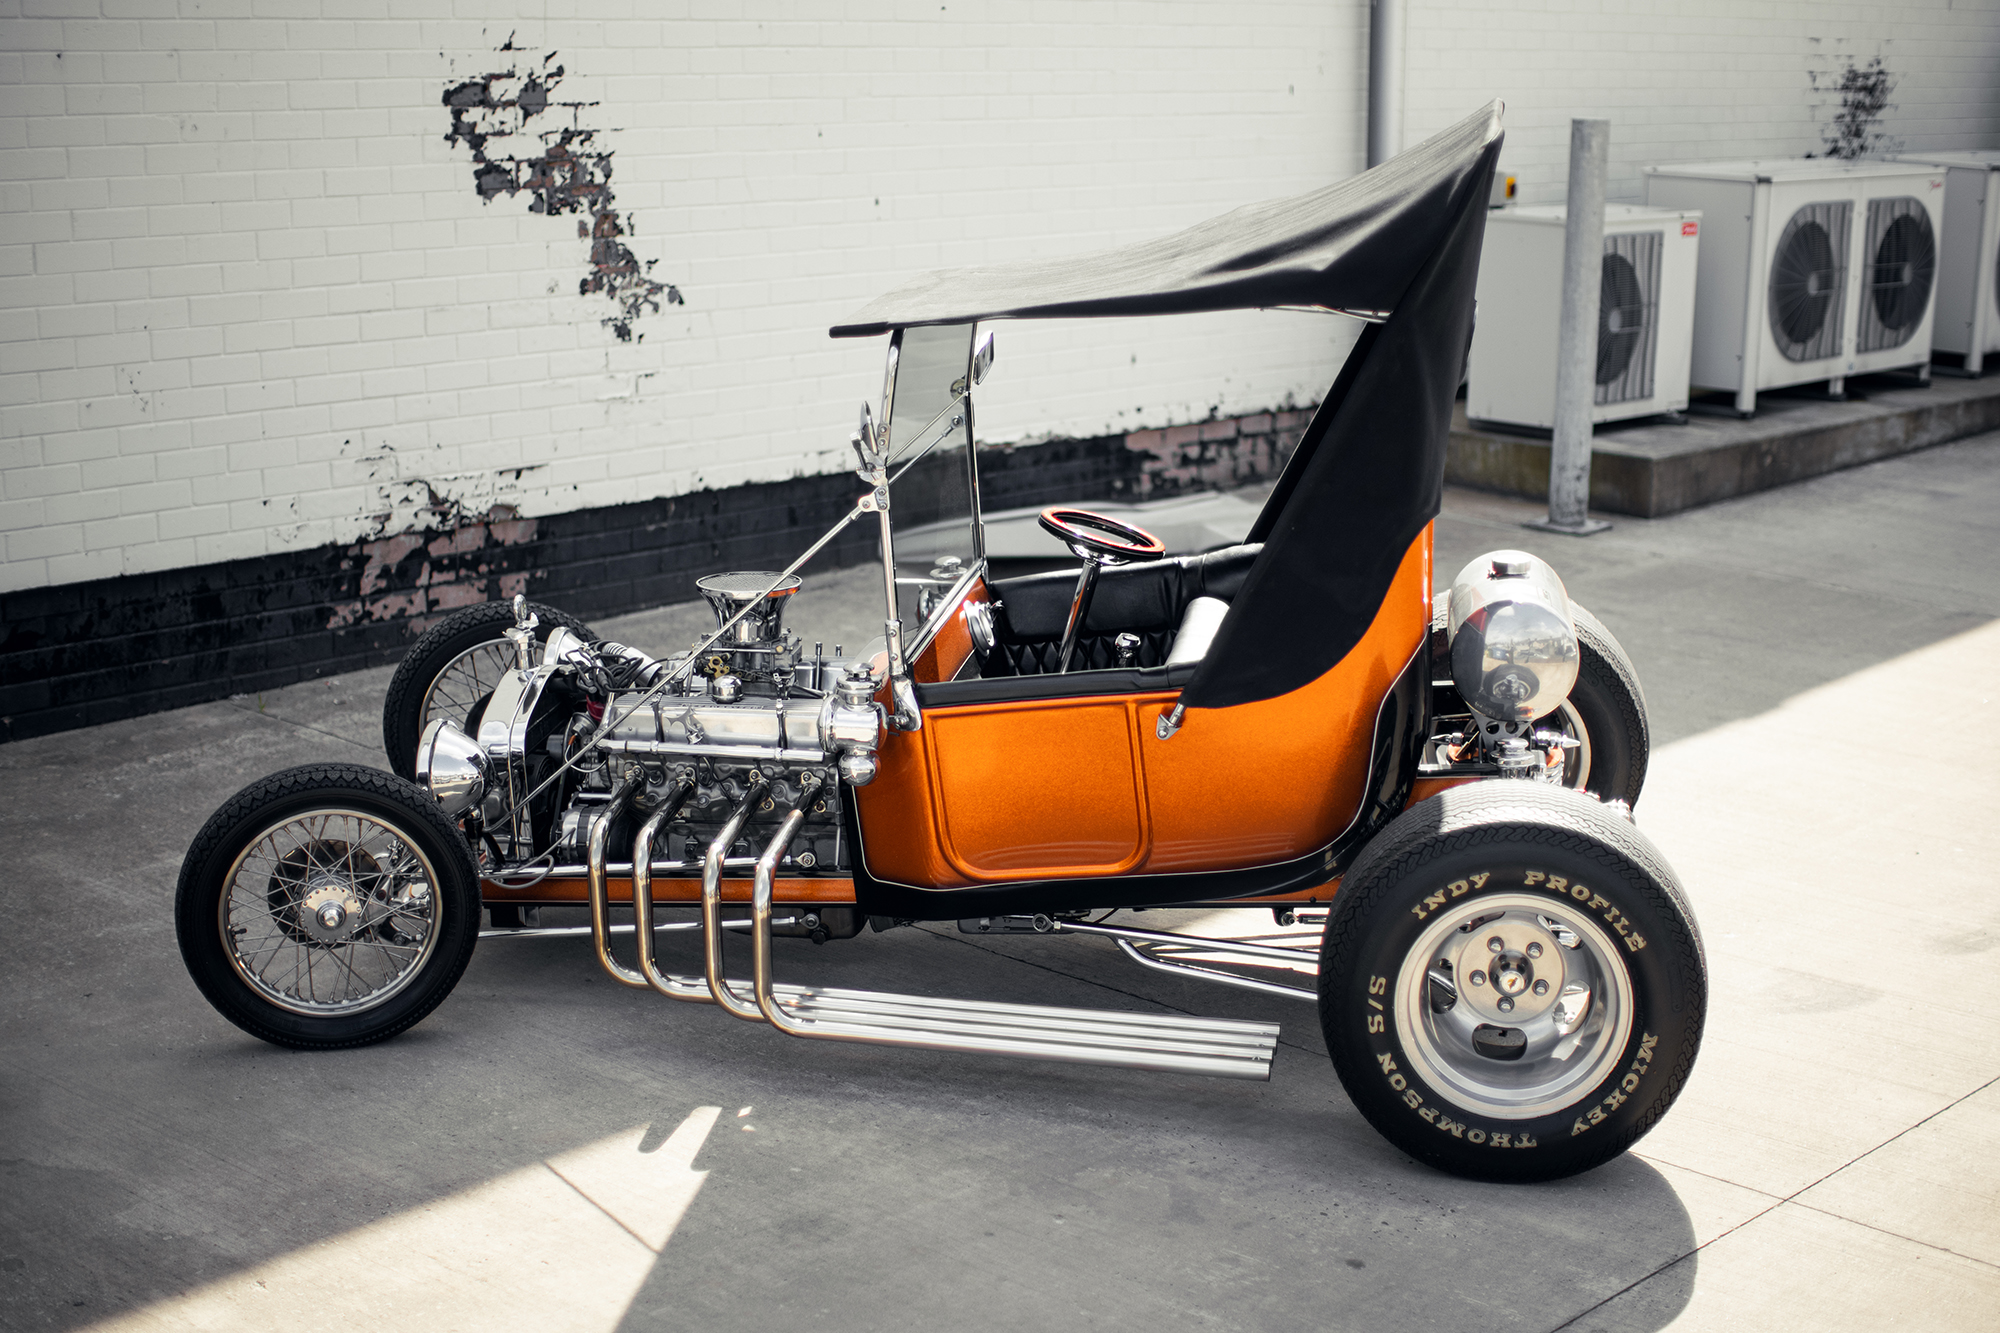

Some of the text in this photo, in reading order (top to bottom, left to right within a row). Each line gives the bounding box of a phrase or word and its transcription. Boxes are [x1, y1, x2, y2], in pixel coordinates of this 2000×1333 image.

[1411, 870, 1647, 953] INDY PROFILE
[1367, 975, 1387, 1034] S/S
[1377, 1031, 1659, 1150] MICKEY THOMPSON
